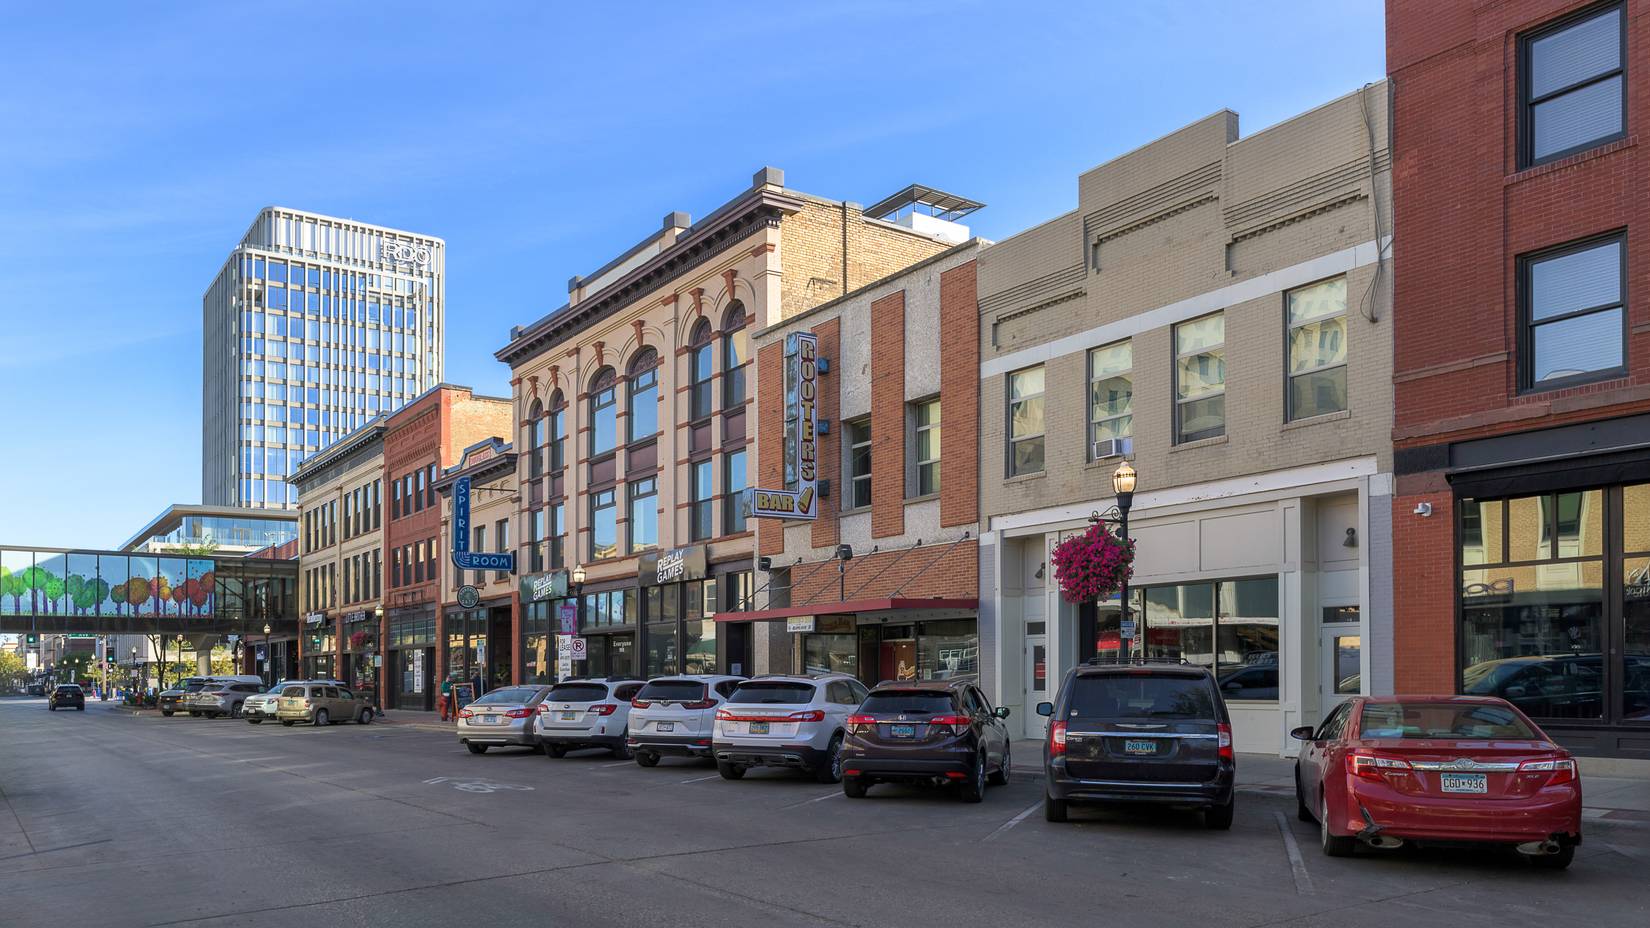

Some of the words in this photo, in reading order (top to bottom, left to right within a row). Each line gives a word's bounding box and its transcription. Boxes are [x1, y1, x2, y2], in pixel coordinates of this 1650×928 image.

[800, 339, 816, 482] ROOTERS
[757, 492, 795, 512] BAR
[458, 484, 466, 550] SPIRIT
[472, 556, 508, 567] ROOM
[657, 549, 684, 573] REPLAY
[657, 563, 684, 584] GAMES
[533, 584, 552, 601] GAMES
